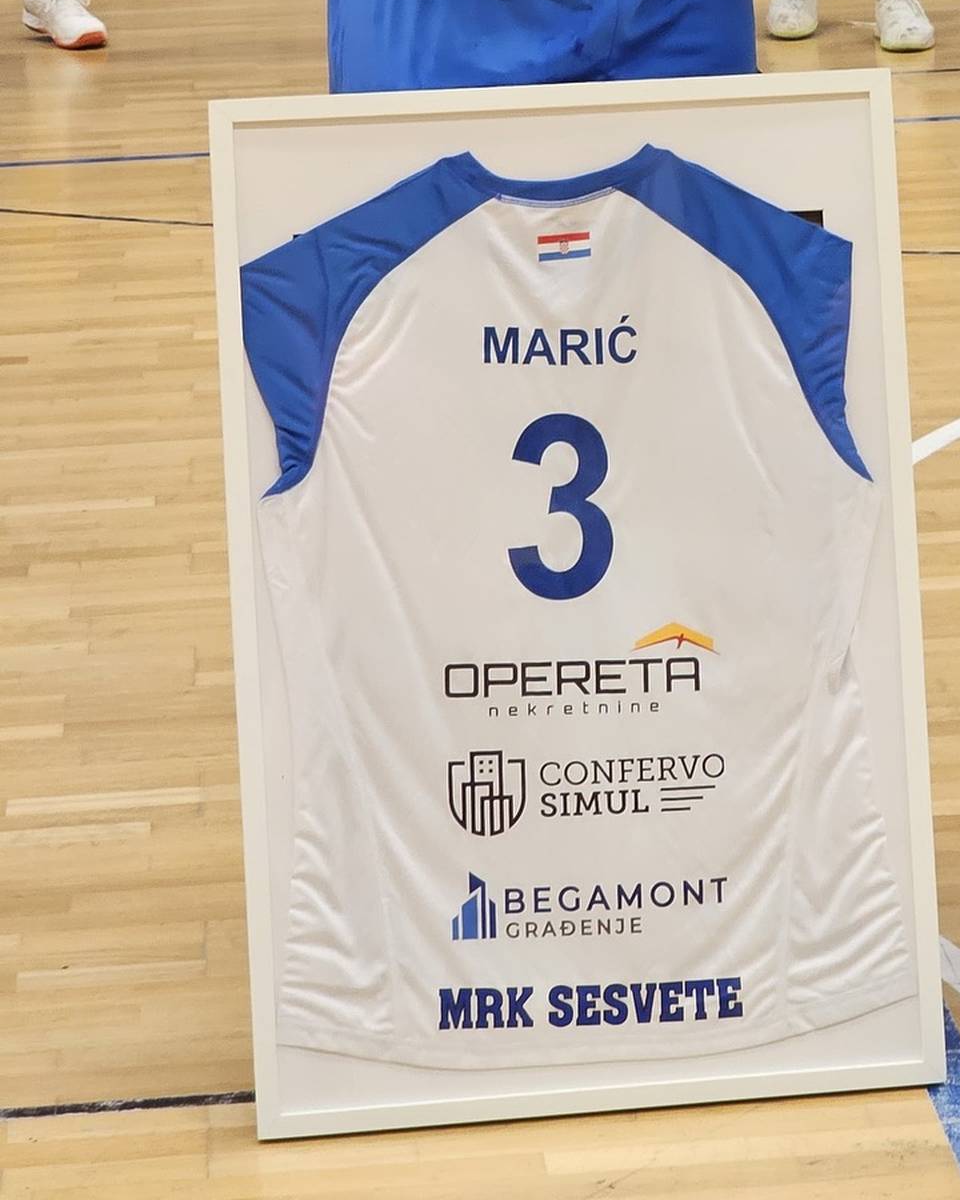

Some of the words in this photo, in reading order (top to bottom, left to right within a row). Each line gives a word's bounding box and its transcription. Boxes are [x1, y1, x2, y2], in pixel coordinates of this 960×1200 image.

[482, 315, 638, 366] MARIĆ
[507, 413, 615, 601] 3
[444, 656, 701, 698] OPERETA
[488, 700, 660, 717] nekretnine
[539, 753, 726, 787] CONFERVO
[540, 789, 650, 818] SIMUL
[503, 876, 728, 915] BEGAMONT
[505, 916, 643, 939] GRAĐENJE
[438, 986, 534, 1031] MRK
[547, 976, 745, 1028] SESVETE
